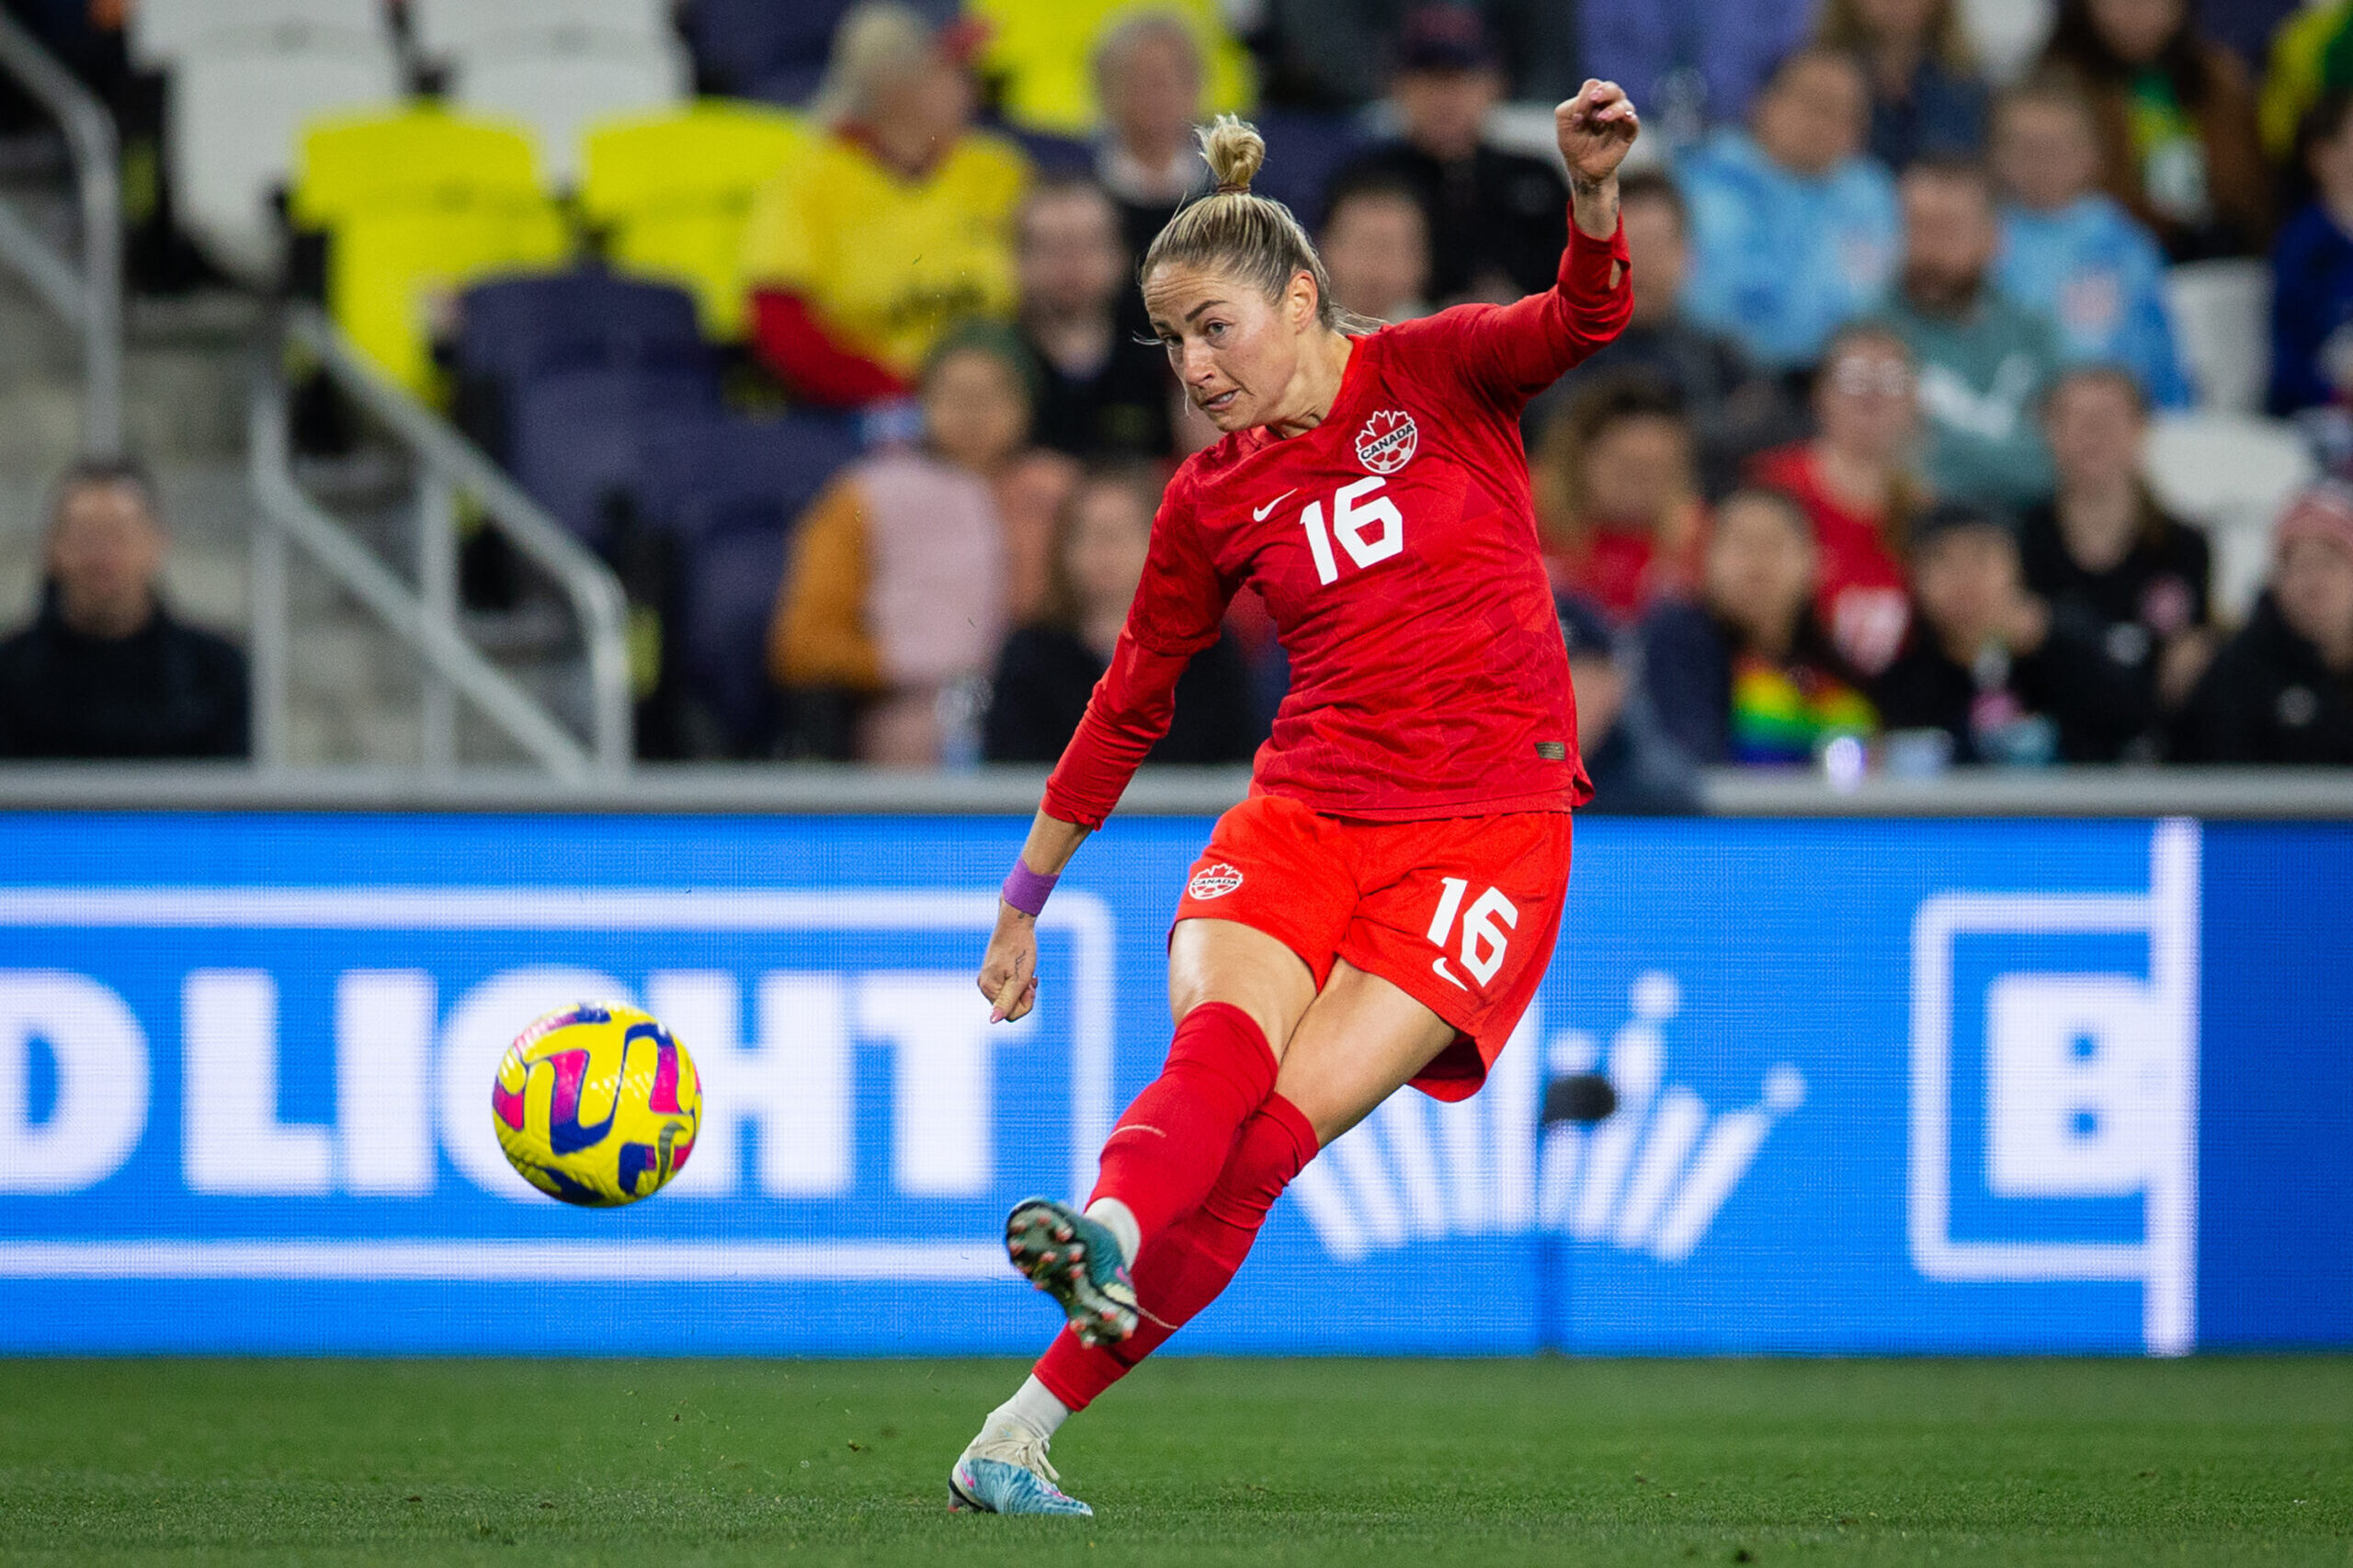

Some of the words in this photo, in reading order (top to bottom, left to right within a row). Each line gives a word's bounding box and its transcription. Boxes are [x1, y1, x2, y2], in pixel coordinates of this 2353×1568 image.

[1360, 423, 1415, 460] CANADA
[1300, 475, 1404, 585] 16
[1191, 878, 1238, 887] CANADA
[1427, 876, 1518, 988] 16
